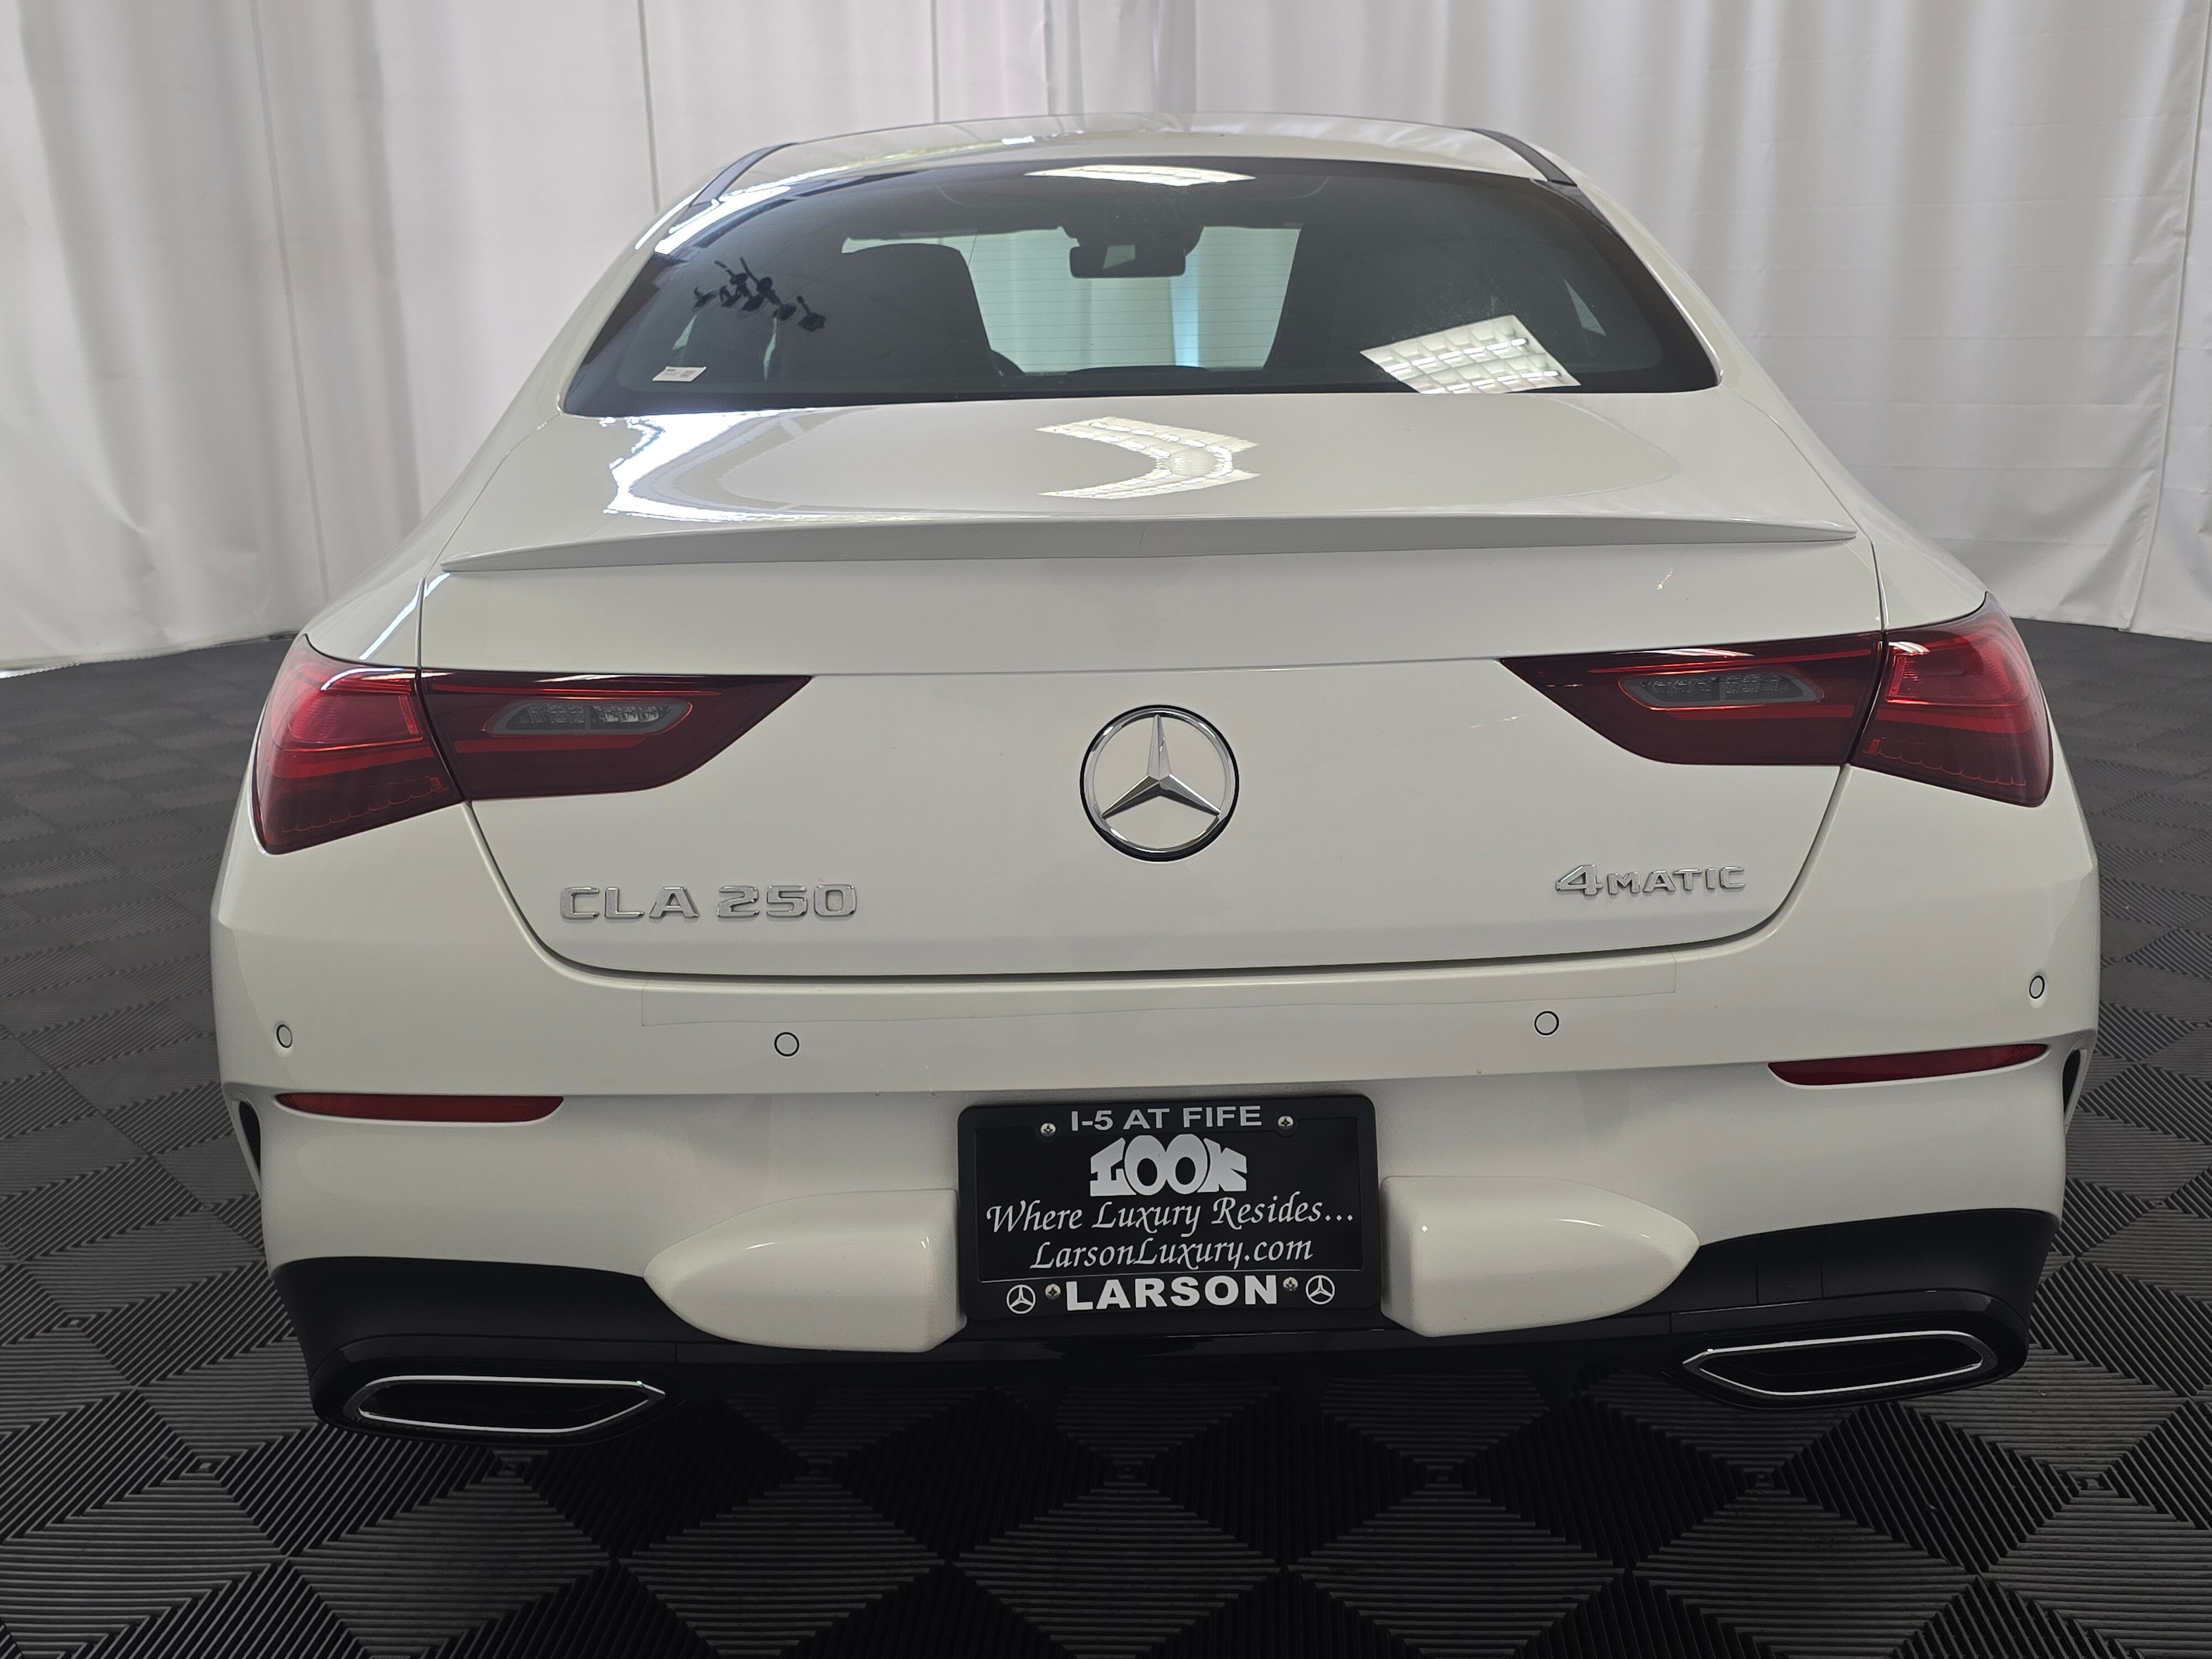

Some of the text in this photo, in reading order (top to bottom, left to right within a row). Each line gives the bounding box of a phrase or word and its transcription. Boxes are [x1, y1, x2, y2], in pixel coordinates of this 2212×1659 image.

[1555, 863, 1746, 896] 4MATIC
[560, 884, 858, 919] CLA 250
[1071, 1105, 1262, 1131] I-5 AT FIFE
[986, 1191, 1354, 1238] Where Luxury Resides...
[1029, 1237, 1314, 1270] LarsonLuxury.com
[1066, 1275, 1277, 1311] LARSON
